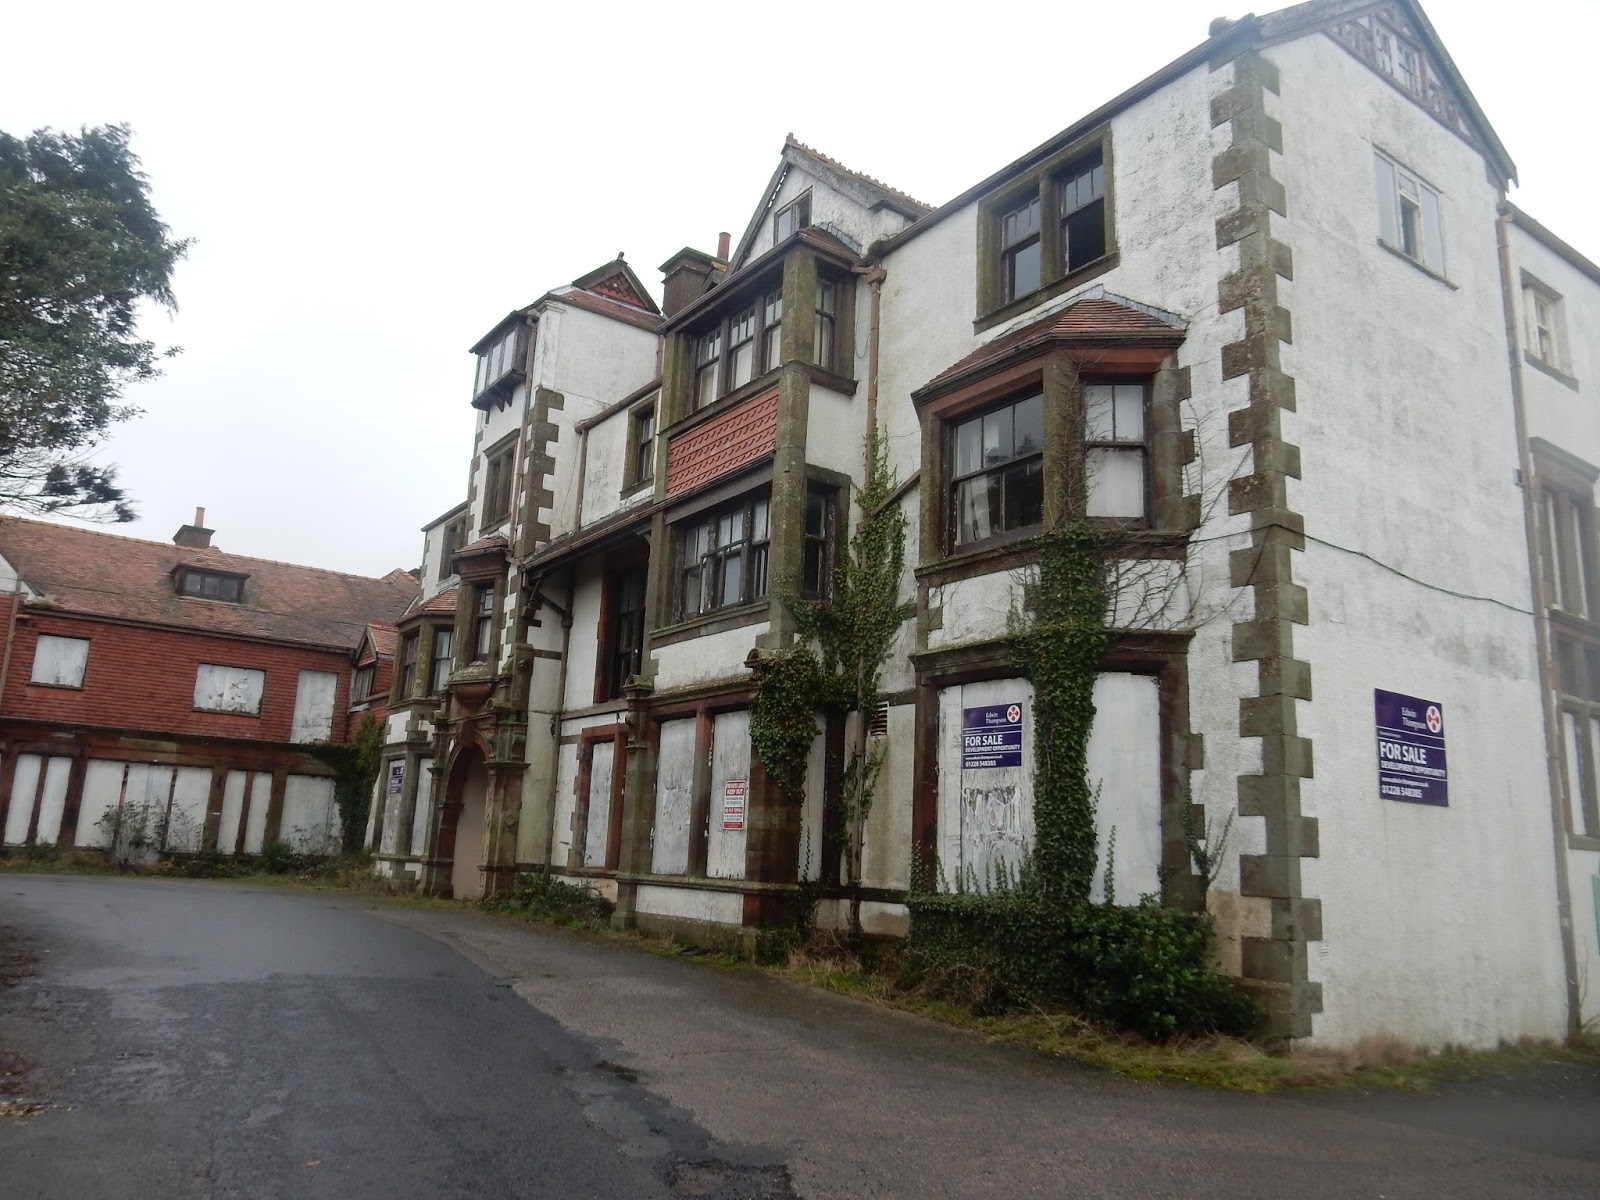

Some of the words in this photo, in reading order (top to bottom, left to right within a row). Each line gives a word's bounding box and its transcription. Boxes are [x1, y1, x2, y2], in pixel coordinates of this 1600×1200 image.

[965, 736, 981, 746] FOR
[982, 735, 1003, 745] SALE
[1380, 741, 1402, 760] FOR
[1402, 745, 1427, 765] SALE
[1381, 760, 1414, 773] DEVELOPMENT
[1414, 766, 1446, 778] OPPORTUNITY
